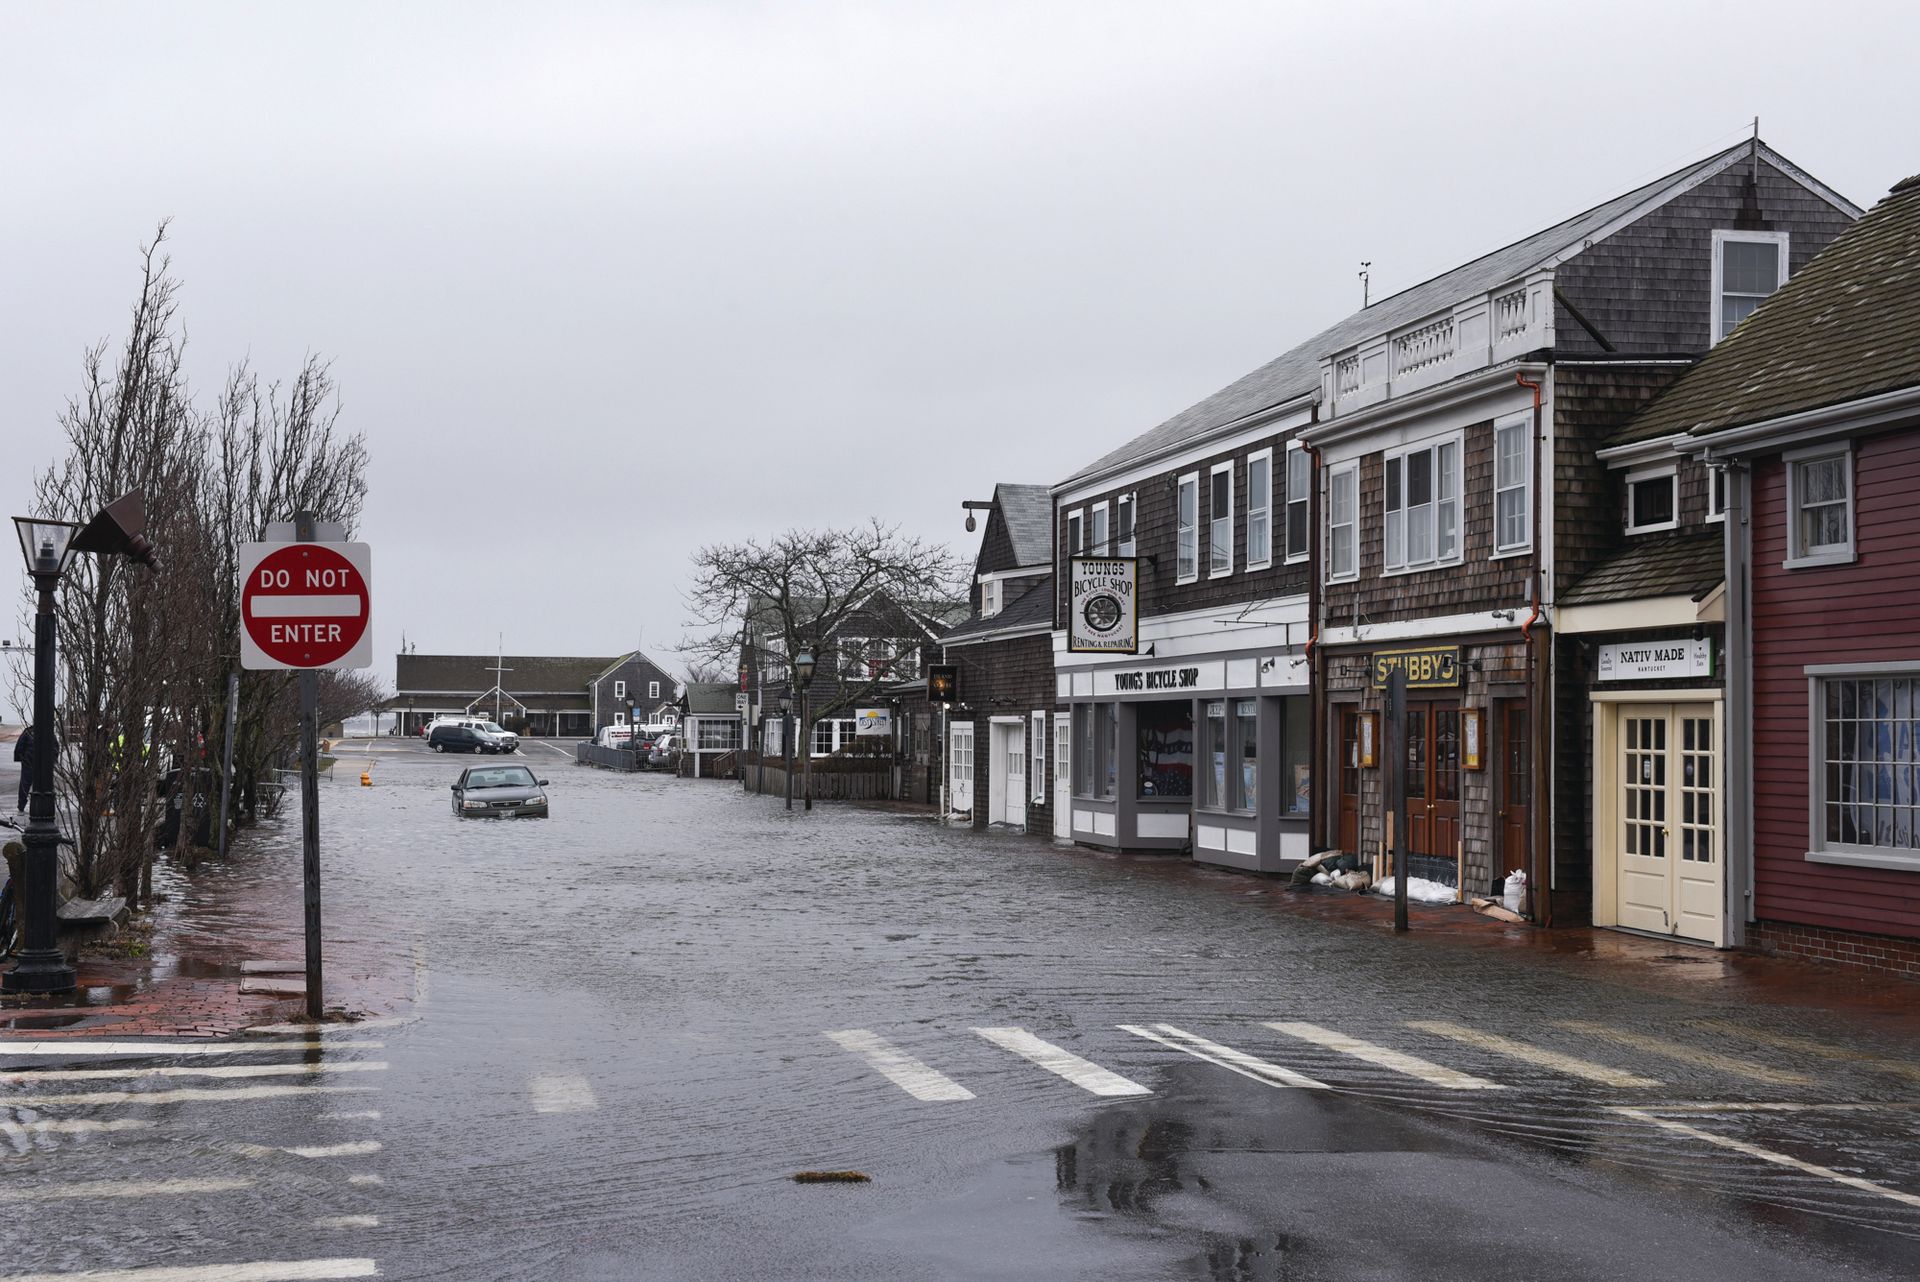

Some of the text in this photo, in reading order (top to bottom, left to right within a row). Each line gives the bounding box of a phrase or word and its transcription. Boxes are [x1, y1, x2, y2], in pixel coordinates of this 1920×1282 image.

[1082, 562, 1125, 575] YOUNGS
[261, 569, 350, 588] DO NOT
[1074, 577, 1133, 597] BICYCLE SHOP
[271, 624, 341, 643] ENTER
[1103, 636, 1134, 649] REPAIRING
[1620, 648, 1685, 664] NATIV MADE
[1114, 667, 1199, 690] YOUNG'S BICYCLE SHOP
